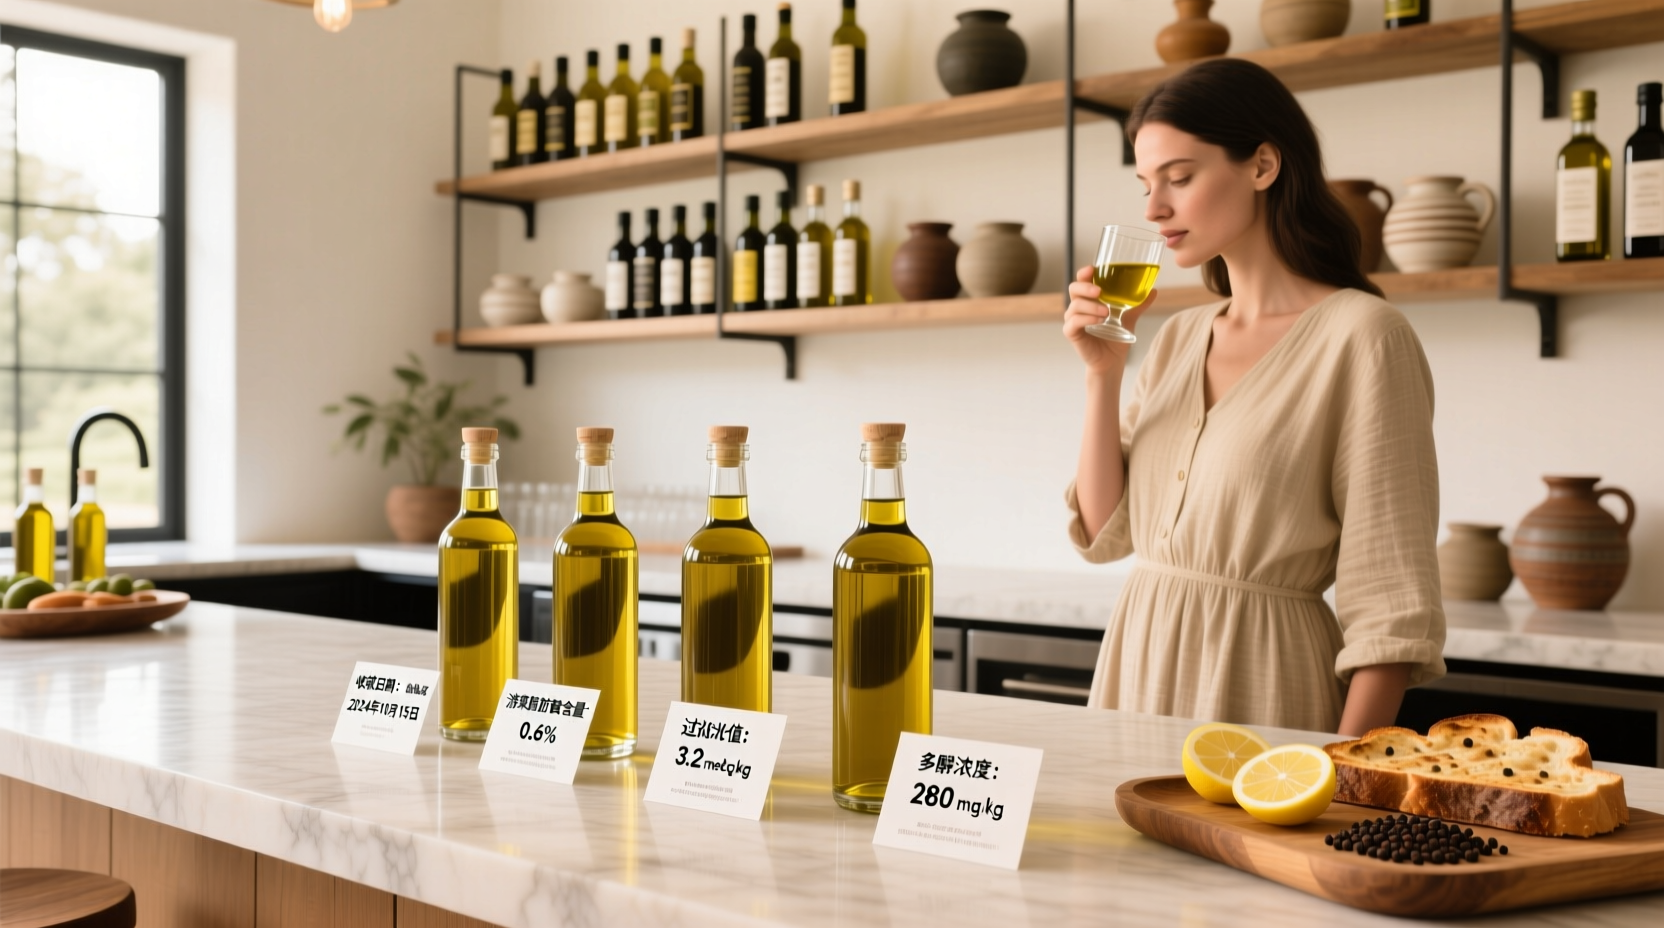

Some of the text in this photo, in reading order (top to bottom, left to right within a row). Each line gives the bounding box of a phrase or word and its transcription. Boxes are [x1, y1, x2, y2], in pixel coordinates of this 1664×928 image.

[519, 721, 557, 744] 0.6%
[675, 745, 705, 769] 3.2
[910, 782, 955, 809] 280
